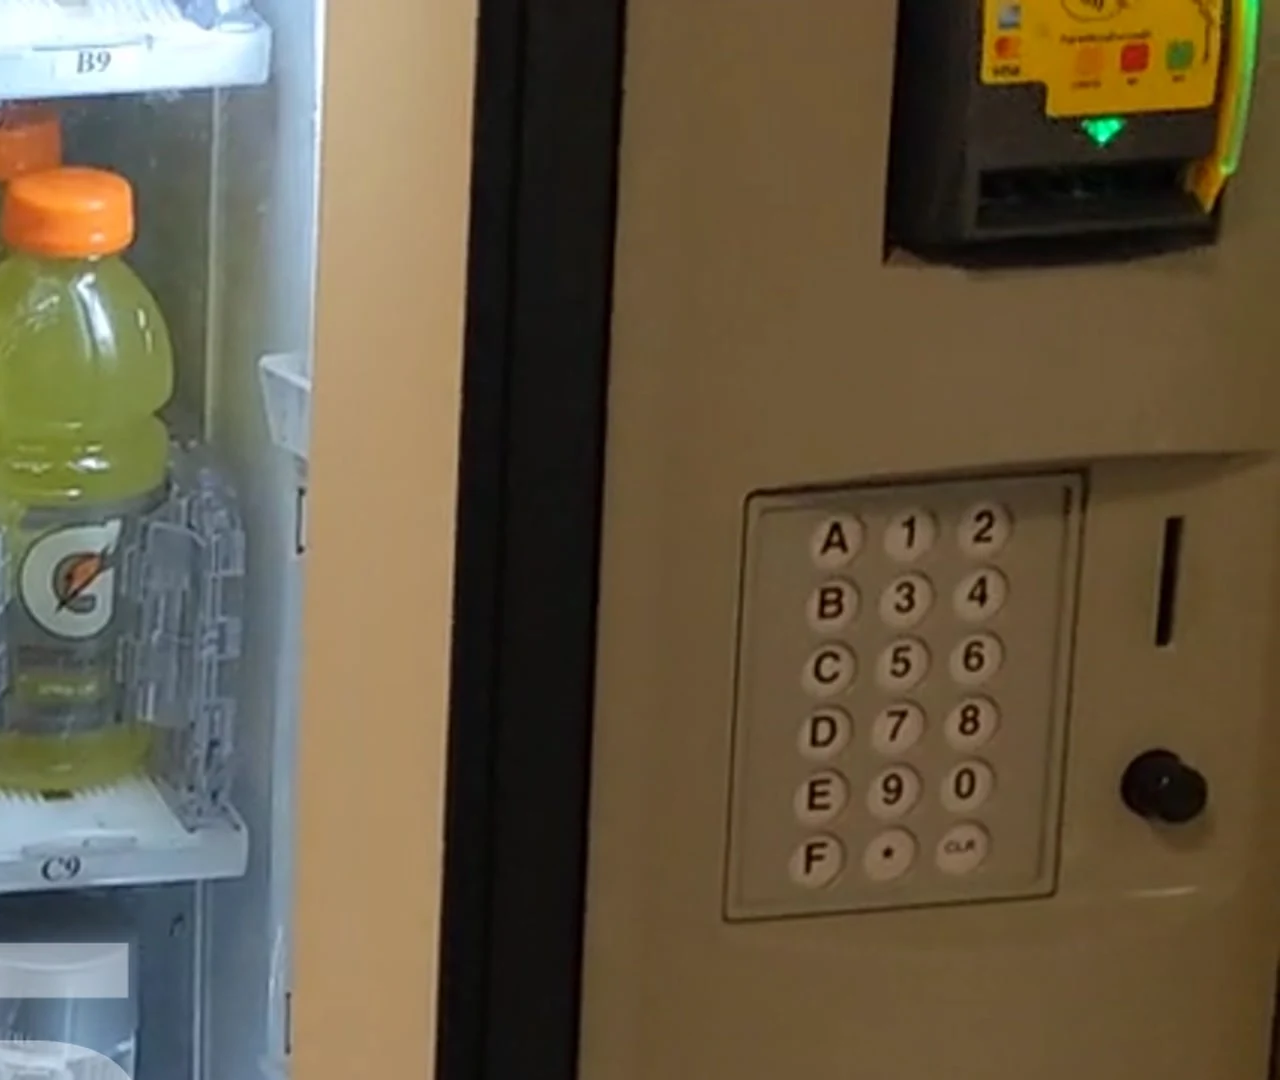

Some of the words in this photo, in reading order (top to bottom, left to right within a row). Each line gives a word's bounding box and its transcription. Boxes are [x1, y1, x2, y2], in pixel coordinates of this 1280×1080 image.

[76, 50, 111, 75] B9
[820, 523, 849, 555] A
[902, 517, 916, 547] 1
[973, 511, 994, 543] 2
[817, 588, 843, 619] B
[895, 582, 916, 613] 3
[968, 576, 988, 607] 4
[813, 651, 840, 683] C
[890, 647, 913, 678] 5
[964, 641, 984, 673] 6
[810, 717, 836, 748] D
[886, 711, 908, 742] 7
[959, 705, 980, 736] 8
[807, 779, 831, 811] E
[882, 774, 903, 805] 9
[954, 769, 976, 800] 0
[42, 855, 81, 882] C9
[803, 843, 828, 874] F
